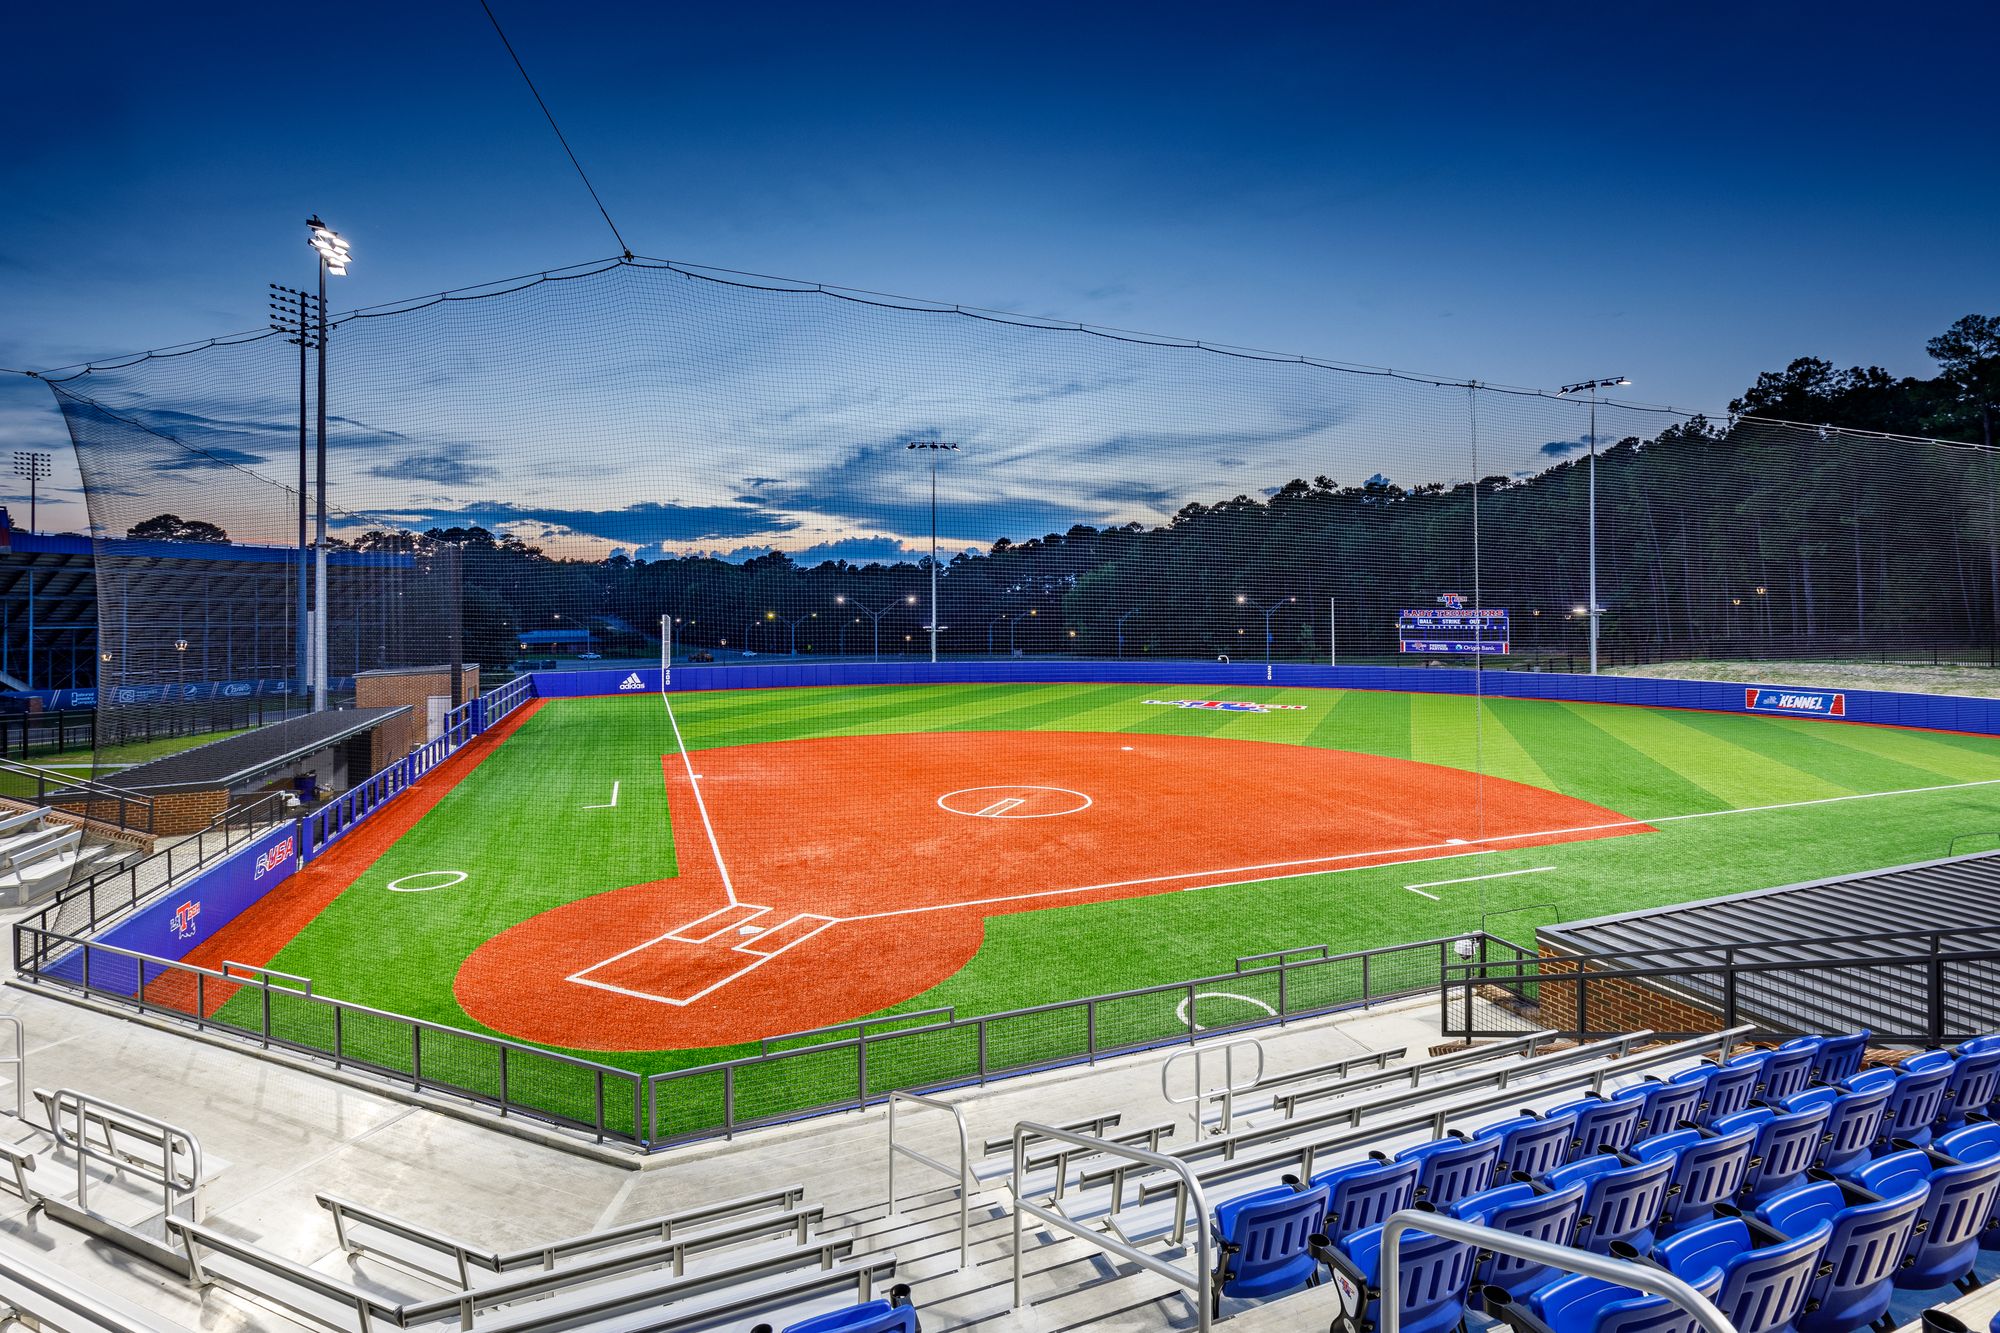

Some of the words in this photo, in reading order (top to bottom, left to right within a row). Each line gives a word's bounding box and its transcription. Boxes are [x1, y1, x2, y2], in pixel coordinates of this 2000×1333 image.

[1403, 609, 1433, 617] LADY
[619, 682, 645, 690] adidas
[1778, 693, 1823, 710] KENNEL
